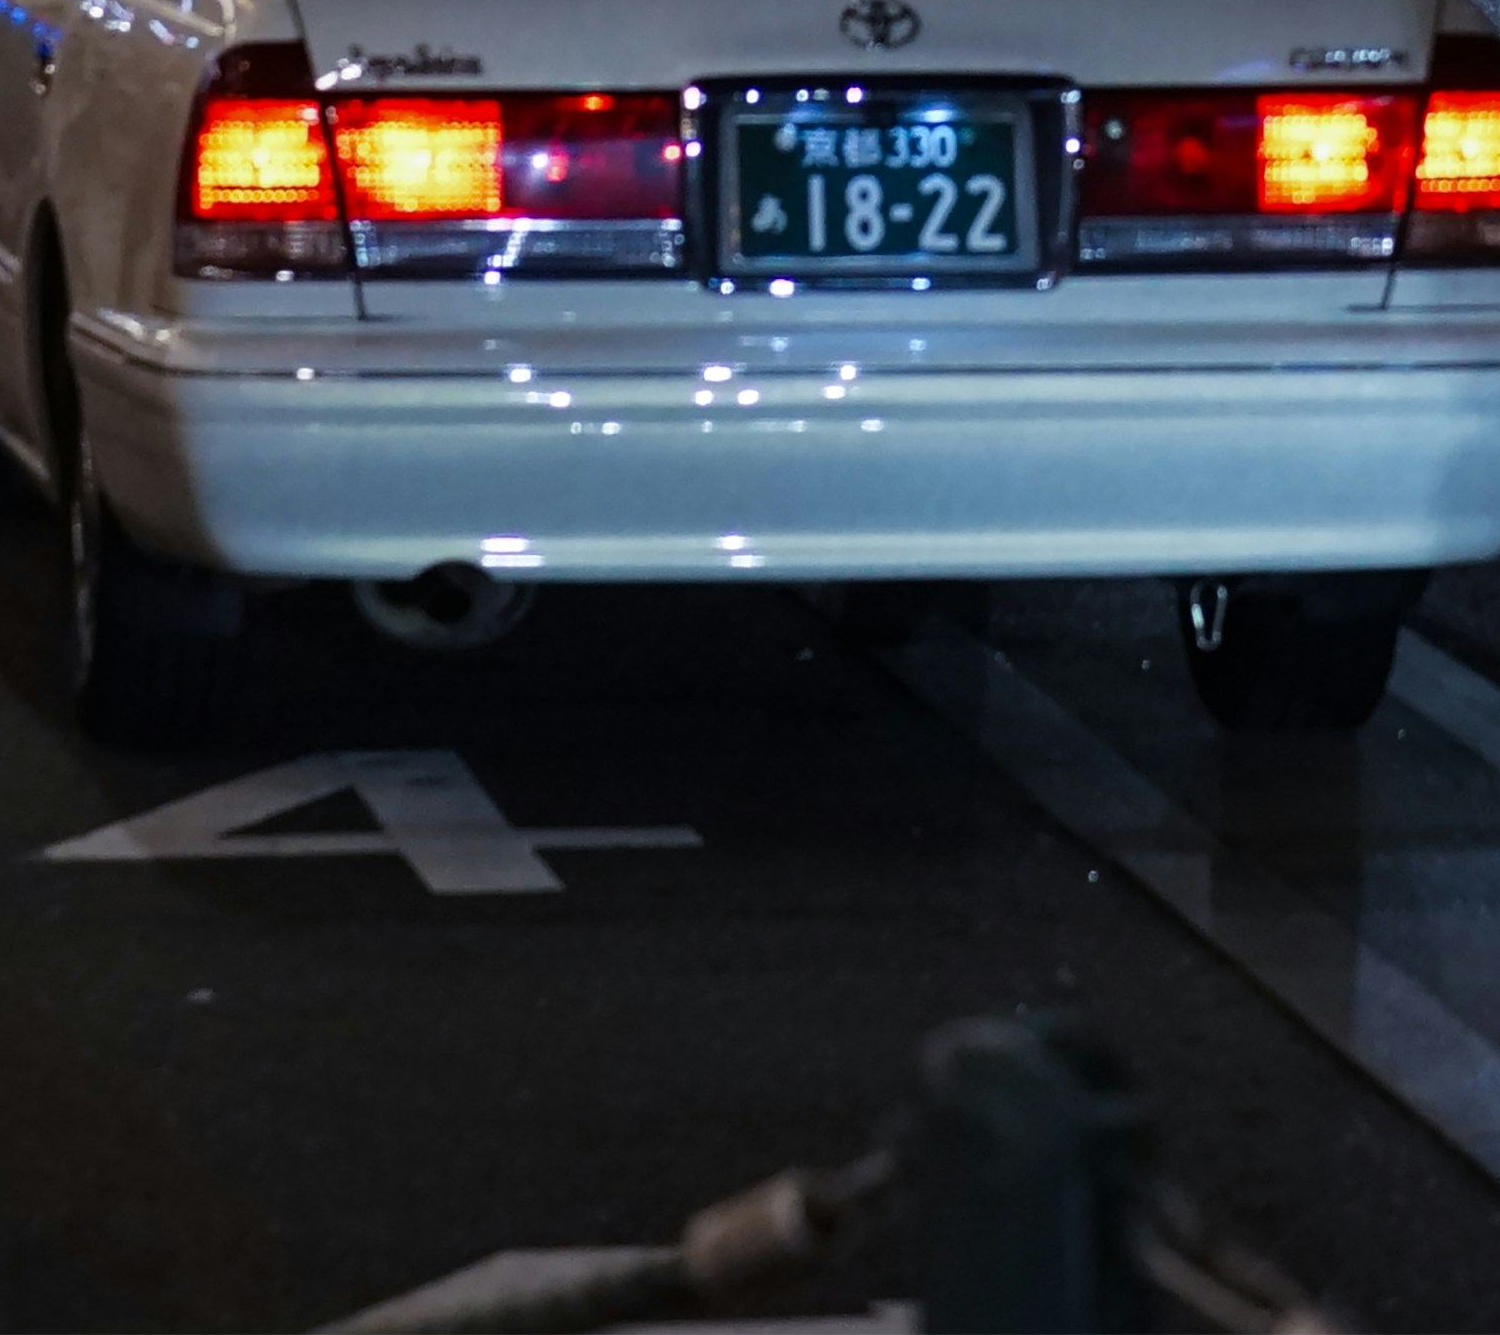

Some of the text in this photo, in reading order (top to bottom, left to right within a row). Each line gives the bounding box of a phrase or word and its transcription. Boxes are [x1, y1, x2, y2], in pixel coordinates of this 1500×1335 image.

[801, 125, 958, 168] 京都 330
[806, 173, 1007, 253] 18-22
